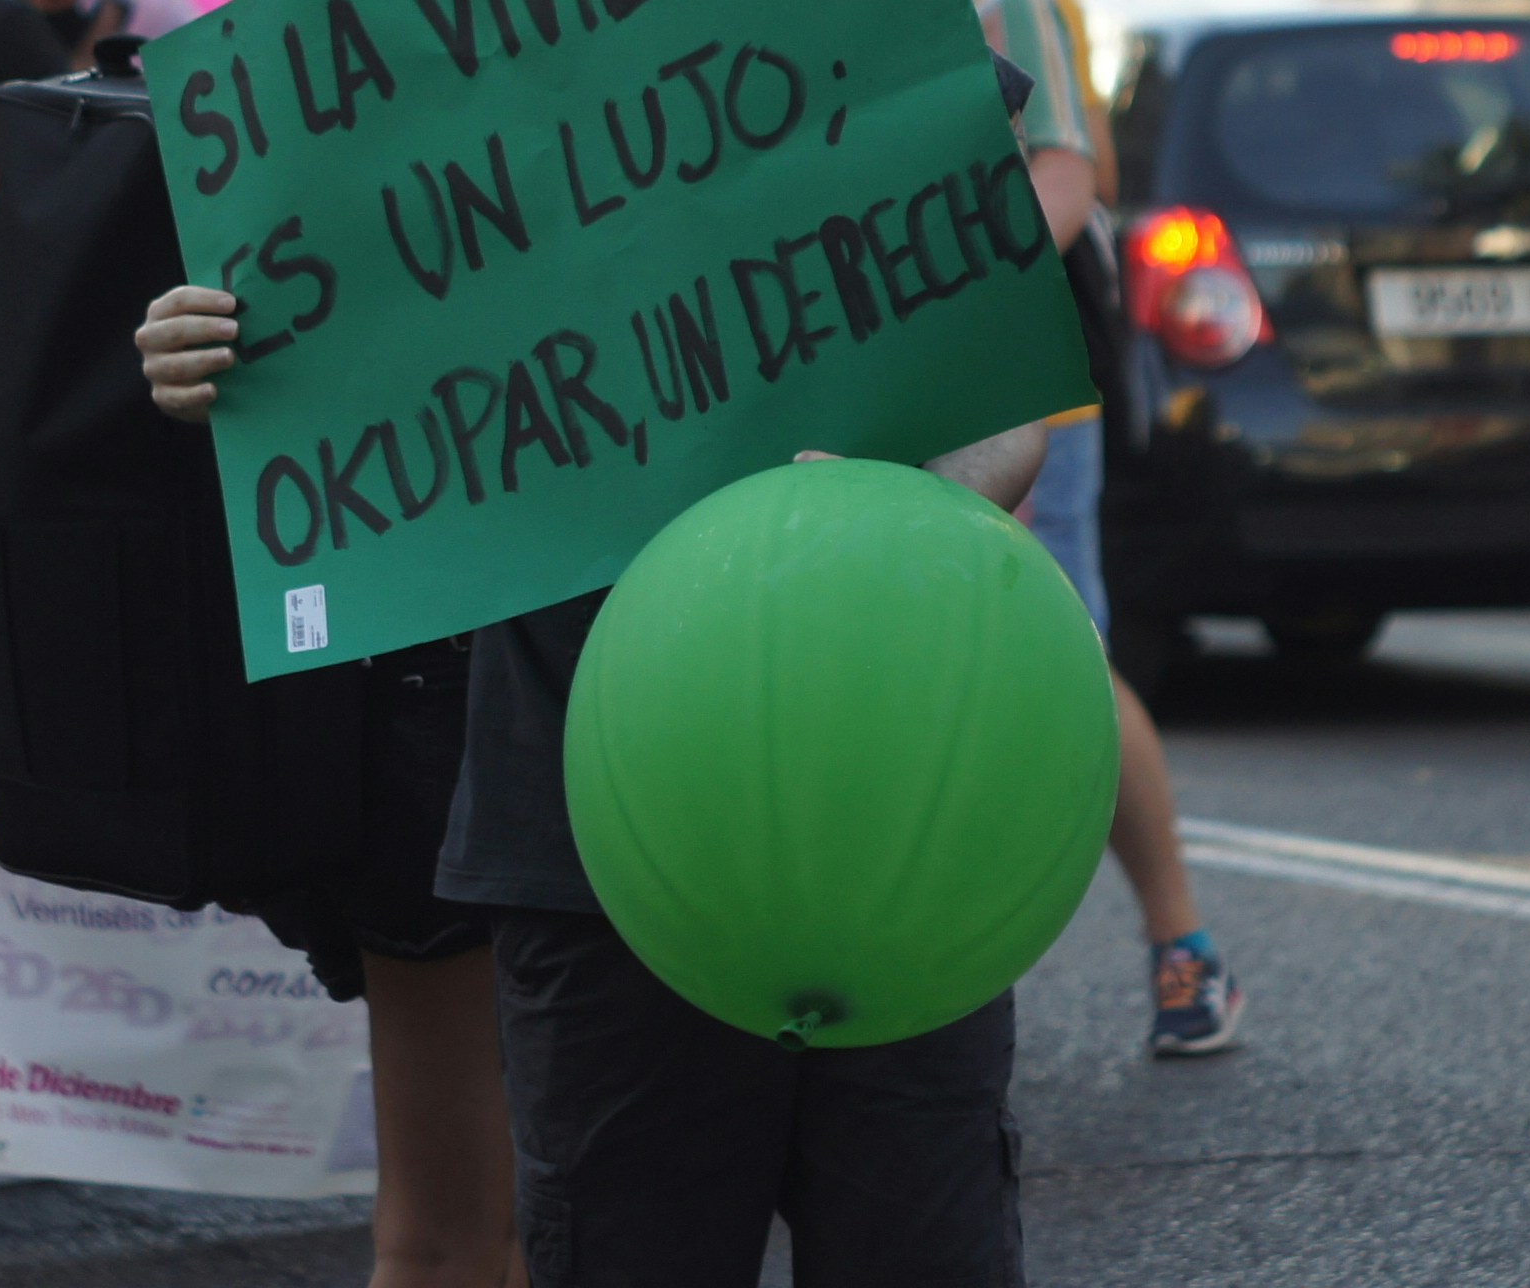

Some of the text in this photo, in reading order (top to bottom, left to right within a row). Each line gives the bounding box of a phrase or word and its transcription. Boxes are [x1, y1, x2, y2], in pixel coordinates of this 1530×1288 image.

[221, 213, 339, 366] ES
[380, 131, 534, 302] UN
[629, 274, 731, 423] UN
[729, 152, 1051, 385] DERECHO
[27, 1062, 183, 1116] Diciembre
